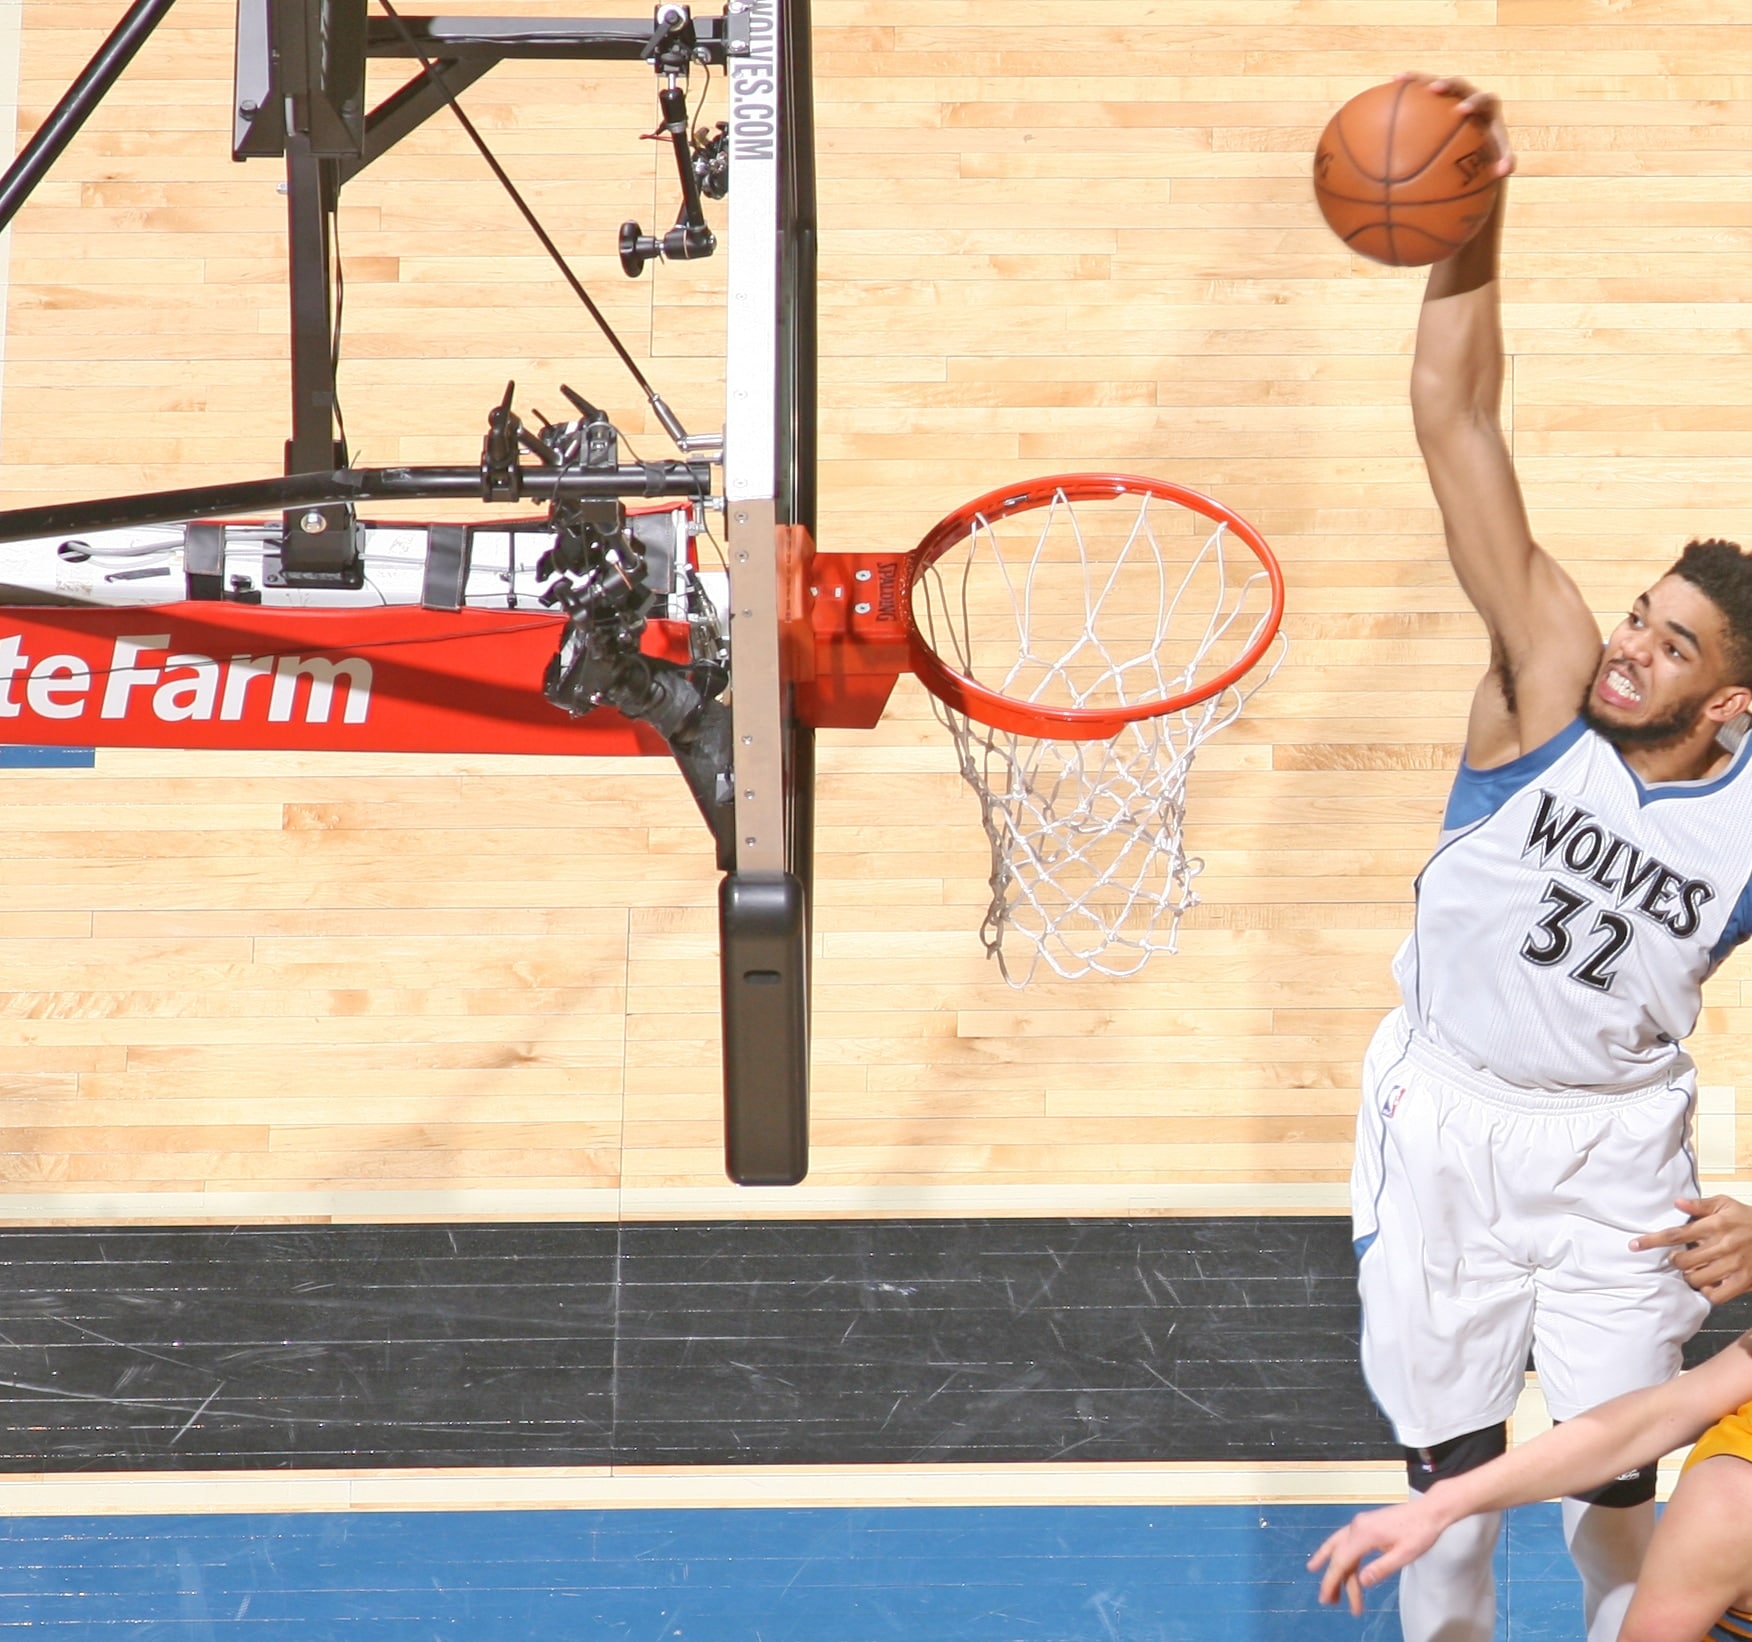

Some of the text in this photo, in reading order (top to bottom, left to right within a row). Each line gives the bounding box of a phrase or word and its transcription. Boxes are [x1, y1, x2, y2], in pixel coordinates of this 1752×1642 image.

[876, 562, 898, 622] SPALDING
[1520, 788, 1716, 939] WOLVES
[1520, 878, 1634, 991] 32
